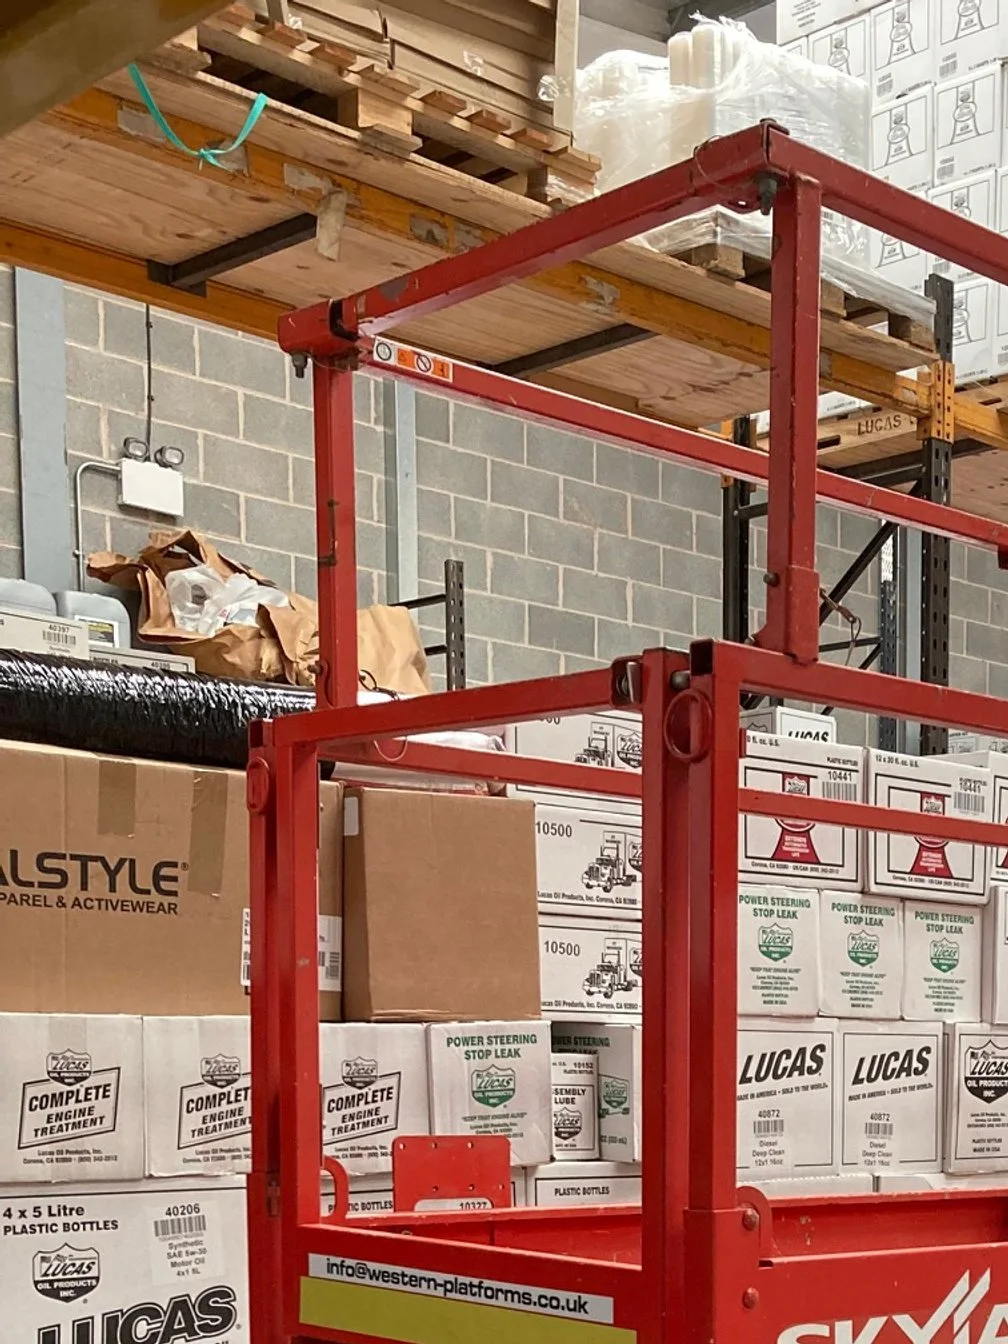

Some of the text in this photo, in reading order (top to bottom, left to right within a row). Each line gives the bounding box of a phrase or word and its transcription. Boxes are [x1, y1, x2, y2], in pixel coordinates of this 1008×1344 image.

[828, 771, 852, 782] 10441
[535, 820, 572, 837] 10500
[0, 893, 178, 915] PAREL & ACTIVEWEAR
[739, 895, 810, 908] POWER STEERING
[753, 908, 798, 919] STOP LEAK
[832, 903, 895, 917] POWER STEERING
[844, 915, 884, 927] STOP LEAK
[915, 911, 974, 925] POWER STEERING
[926, 924, 963, 934] STOP LEAK
[544, 940, 580, 956] 10500
[446, 1034, 538, 1047] POWER STEERING
[574, 1036, 610, 1048] STEERING
[464, 1048, 521, 1060] STOP LEAK
[53, 1061, 89, 1071] LUCAS
[739, 1043, 827, 1085] LUCAS
[852, 1045, 932, 1086] LUCAS
[477, 1078, 513, 1089] LUCAS
[29, 1083, 112, 1112] COMPLETE
[553, 1088, 587, 1096] SEMBLY
[186, 1087, 251, 1114] COMPLET
[327, 1086, 394, 1113] COMPLETE
[554, 1097, 576, 1105] LUBE
[46, 1106, 95, 1124] ENGINE
[202, 1107, 244, 1125] ENGINE
[341, 1107, 381, 1123] ENGINE
[758, 1109, 780, 1119] 40872
[870, 1112, 890, 1122] 40872
[34, 1116, 105, 1138] TREATMENT
[331, 1115, 389, 1136] TREATMENT
[554, 1186, 610, 1196] PLASTIC BOTTLES
[3, 1204, 85, 1219] 4 x 5 Litre
[165, 1203, 200, 1217] 40206
[361, 1200, 393, 1211] BOTTLES
[3, 1220, 119, 1236] PLASTIC BOTTLES
[168, 1240, 204, 1251] Synthetic
[166, 1251, 184, 1260] SAE
[42, 1261, 96, 1277] LUCAS
[170, 1257, 206, 1268] Motor Oil
[37, 1279, 97, 1290] OIL PRODUCTS
[326, 1258, 589, 1315] info@western-platforms.co.uk
[60, 1289, 77, 1297] INC.
